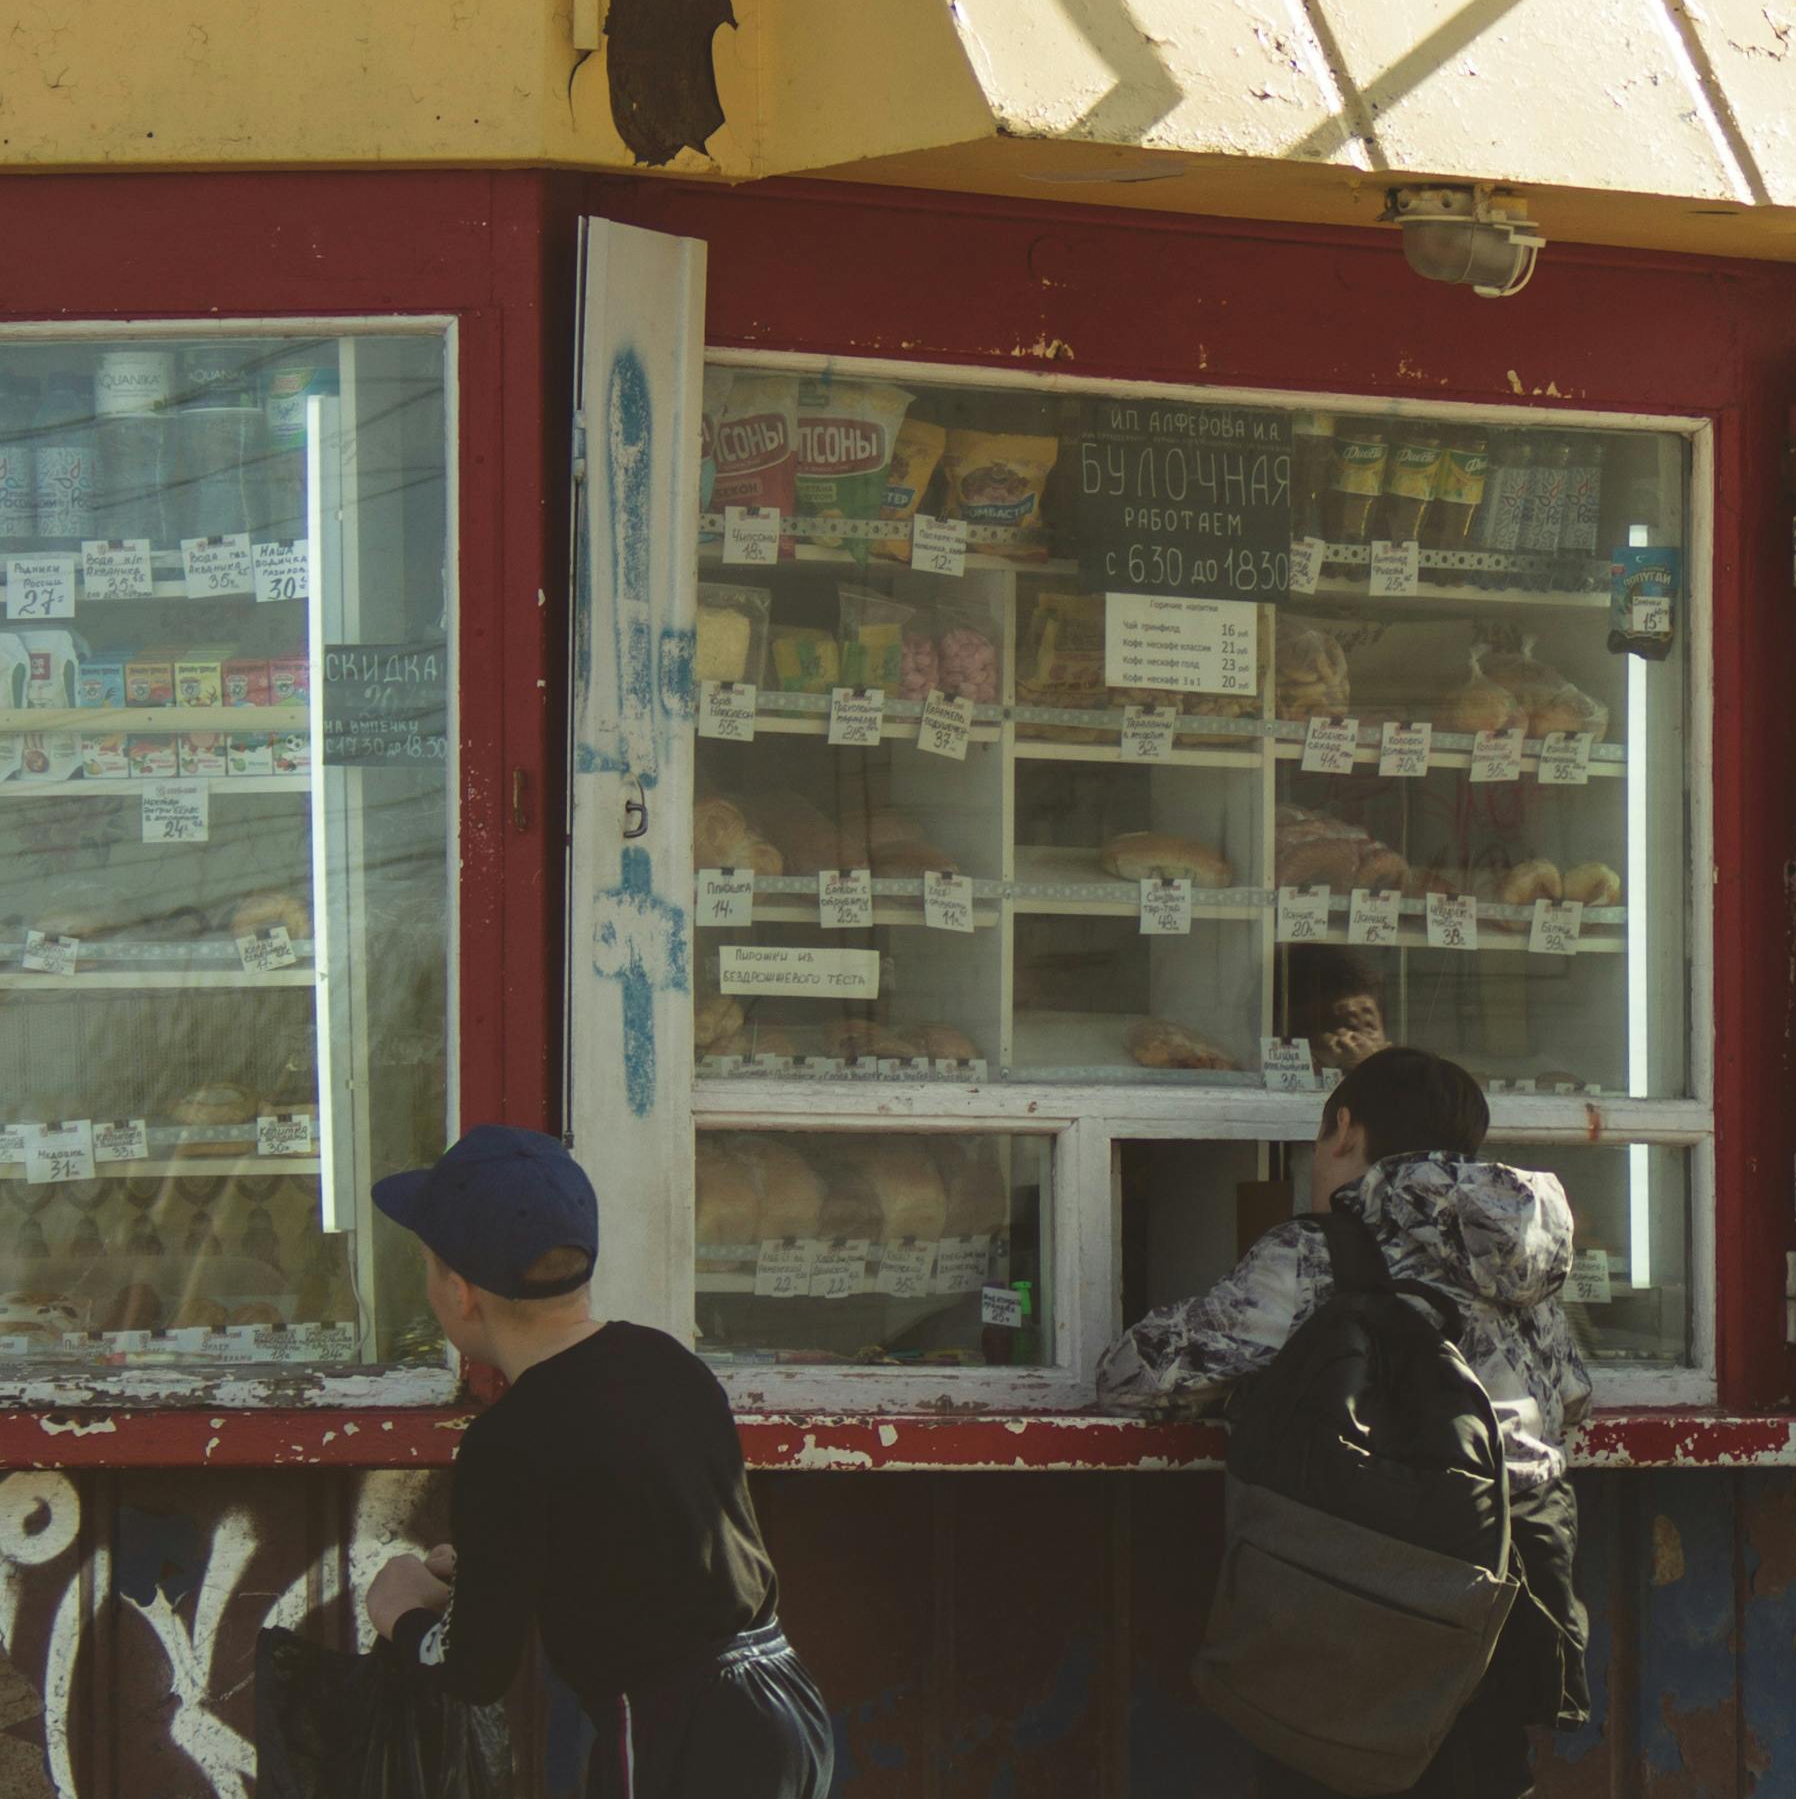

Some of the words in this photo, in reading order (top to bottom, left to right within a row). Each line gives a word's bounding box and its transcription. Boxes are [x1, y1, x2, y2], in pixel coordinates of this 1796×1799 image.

[1150, 411, 1245, 438] АЛФЕРОВА
[799, 426, 877, 464] ПСОНЫ
[1082, 442, 1290, 507] БУЛОЧНАЯ
[1125, 507, 1243, 537] РАБОТАЕМ
[1123, 620, 1138, 630] Чай
[1222, 624, 1236, 637] 16
[1123, 638, 1143, 649] Кофе
[1147, 640, 1179, 651] нескафе
[1222, 641, 1235, 655] 21
[326, 652, 438, 683] СКИДКА
[1123, 656, 1143, 666] Кофе
[1147, 658, 1179, 669] нескафе
[1222, 658, 1236, 671] 23
[1123, 673, 1143, 684] Кофе
[1222, 675, 1236, 689] 20
[707, 881, 752, 895] Плюшка
[827, 973, 865, 986] ТЕСТА
